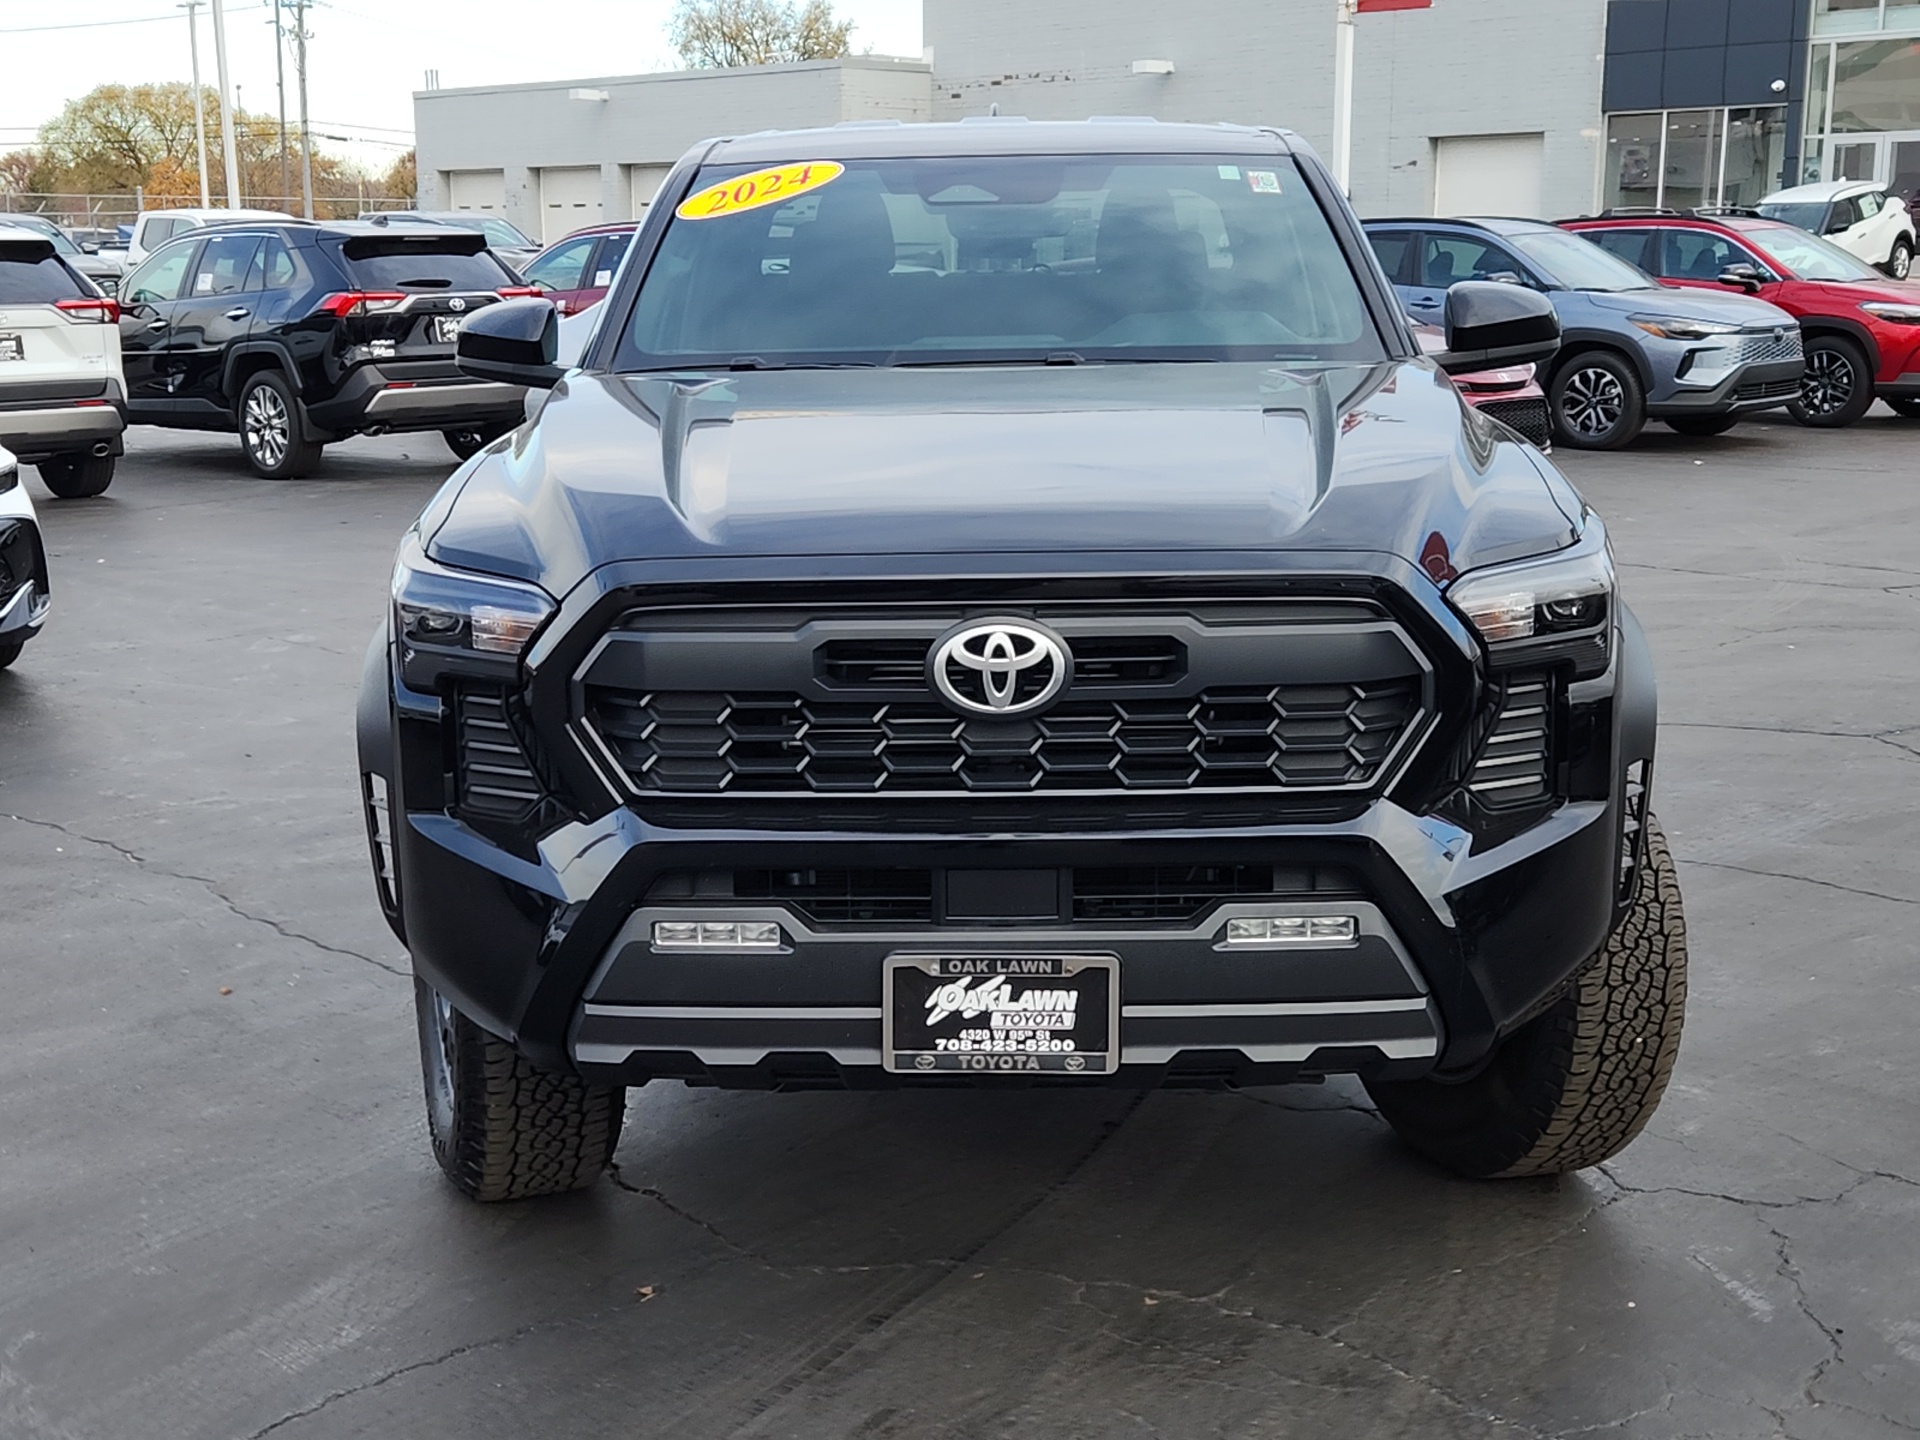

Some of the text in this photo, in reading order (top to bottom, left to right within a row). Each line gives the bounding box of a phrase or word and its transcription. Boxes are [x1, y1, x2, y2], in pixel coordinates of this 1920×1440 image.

[706, 165, 813, 215] 2024
[948, 960, 1052, 973] OAK LAWN
[1000, 1013, 1066, 1026] TOYOTA
[958, 1029, 991, 1041] 4320
[992, 1029, 1006, 1041] W
[1035, 1029, 1051, 1041] St
[935, 1038, 1076, 1052] 708-423-5200
[957, 1055, 1041, 1070] TOYOTA
